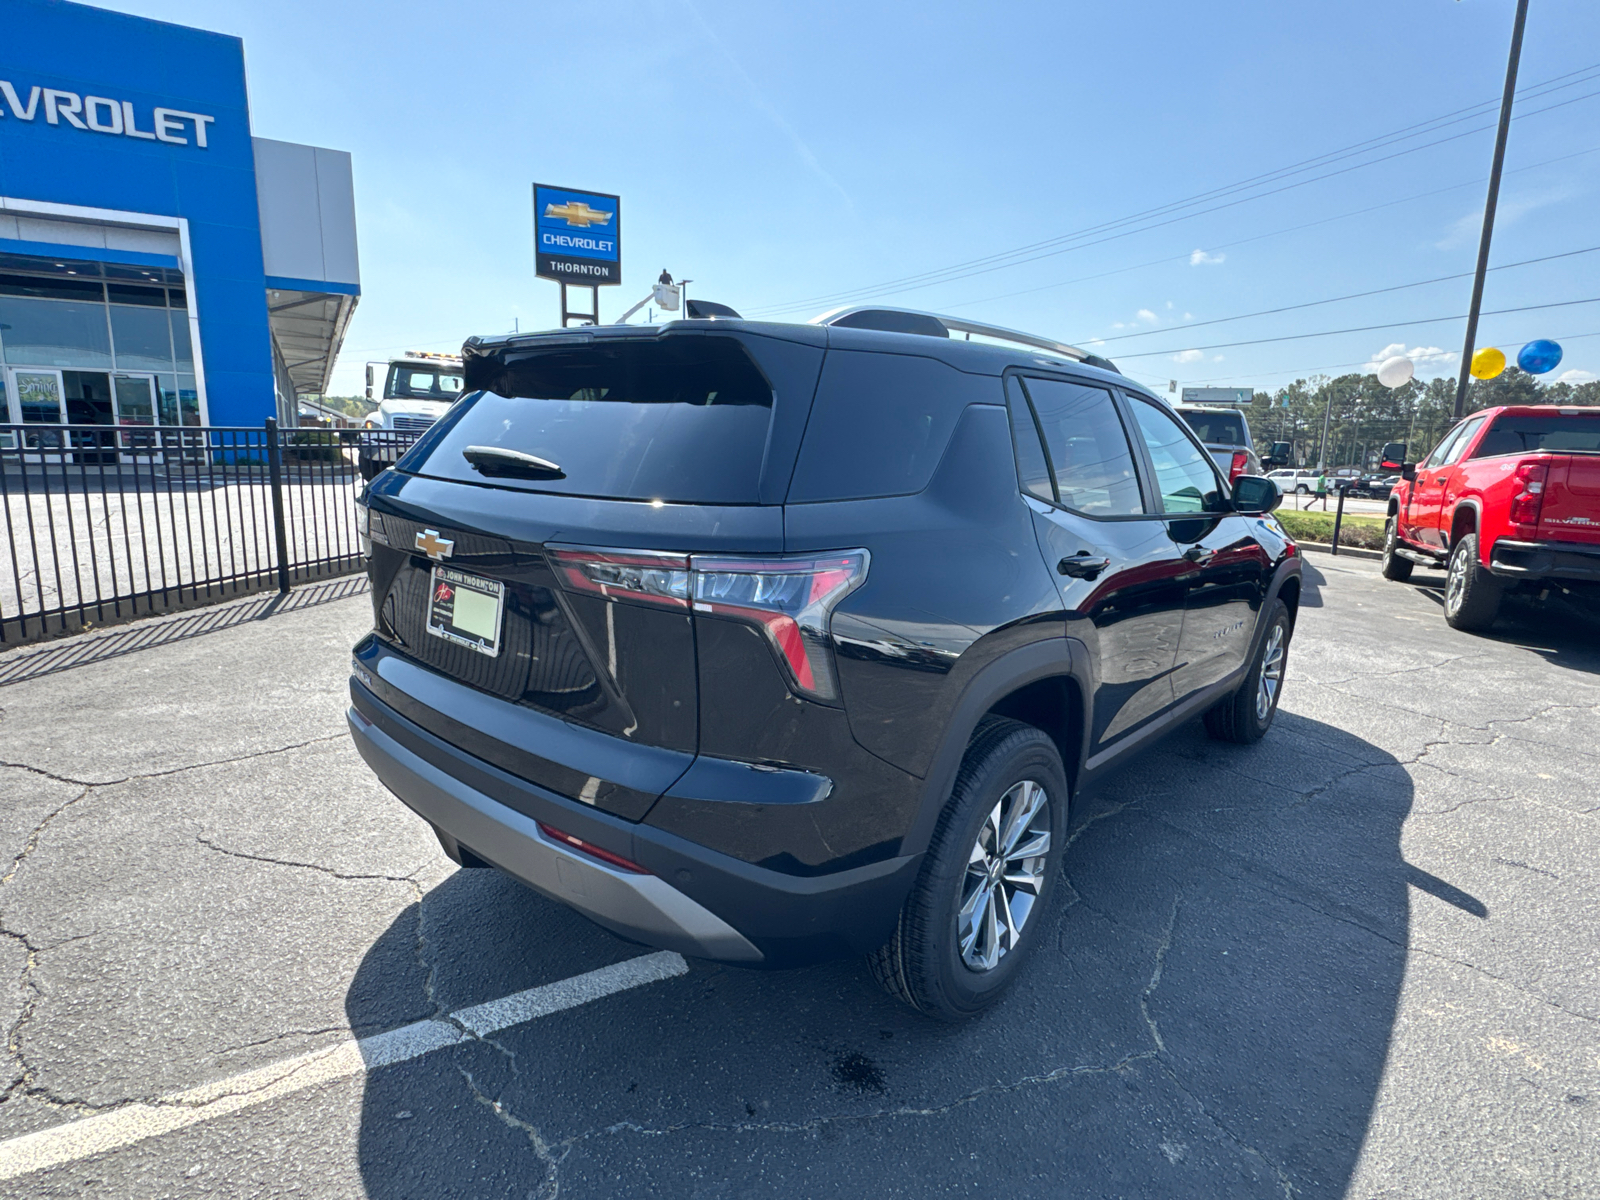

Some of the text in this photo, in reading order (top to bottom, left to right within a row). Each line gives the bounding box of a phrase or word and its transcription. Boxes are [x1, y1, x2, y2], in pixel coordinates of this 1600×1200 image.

[0, 80, 215, 148] VROLET
[543, 233, 614, 252] CHEVROLET
[550, 261, 609, 277] THORNTON
[446, 570, 463, 583] JOHN
